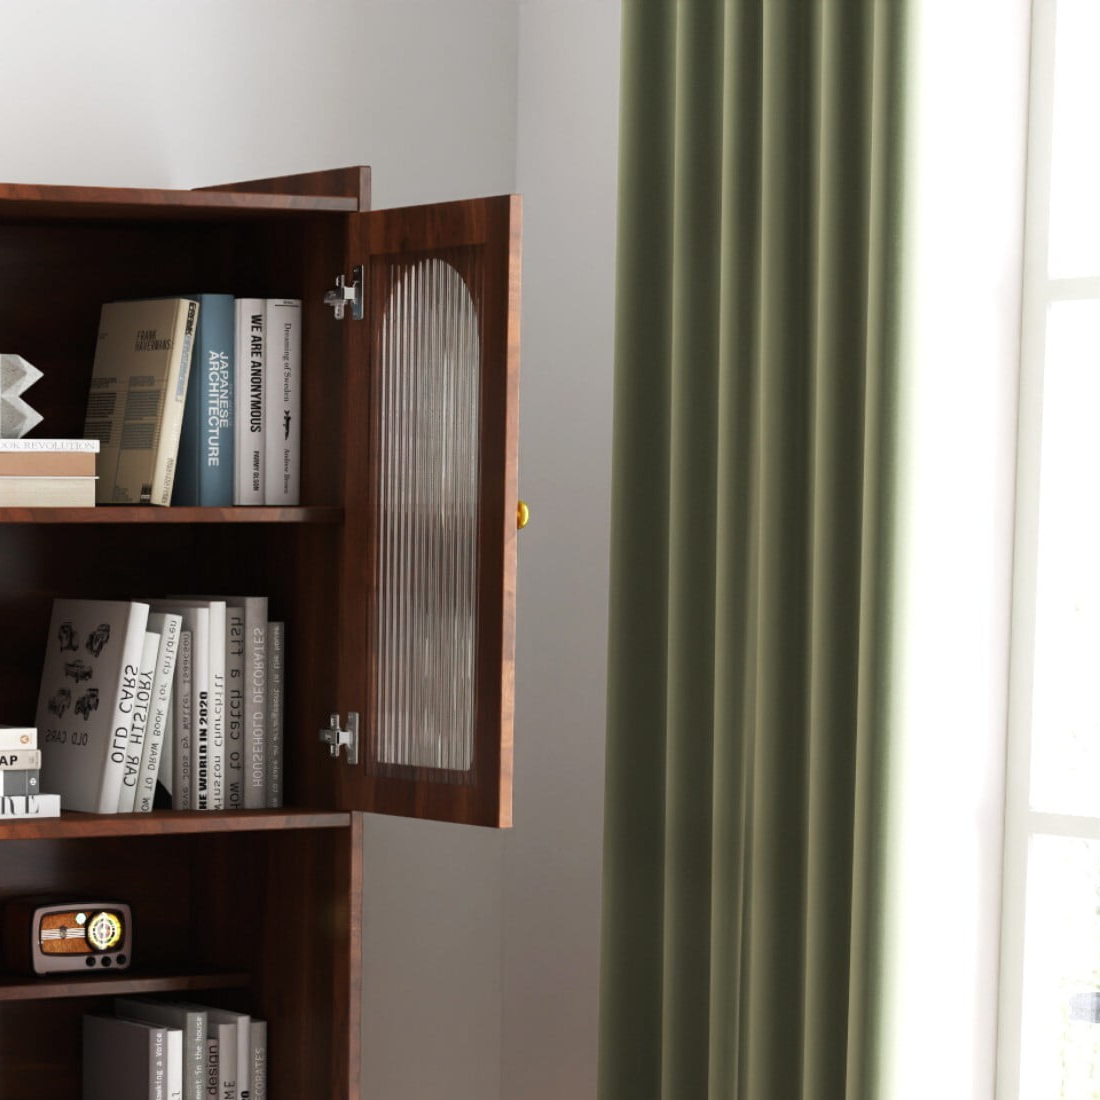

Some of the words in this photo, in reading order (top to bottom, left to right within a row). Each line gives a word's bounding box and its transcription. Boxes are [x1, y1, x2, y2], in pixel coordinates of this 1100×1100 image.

[250, 314, 262, 332] WE
[282, 322, 291, 361] Dreaming
[250, 335, 262, 358] ARE
[208, 351, 219, 466] ARCHITECTURE
[219, 352, 229, 428] JAPANESE
[250, 361, 262, 433] ANONYMOUS
[24, 441, 95, 450] REVOLUTION
[207, 1044, 219, 1095] design
